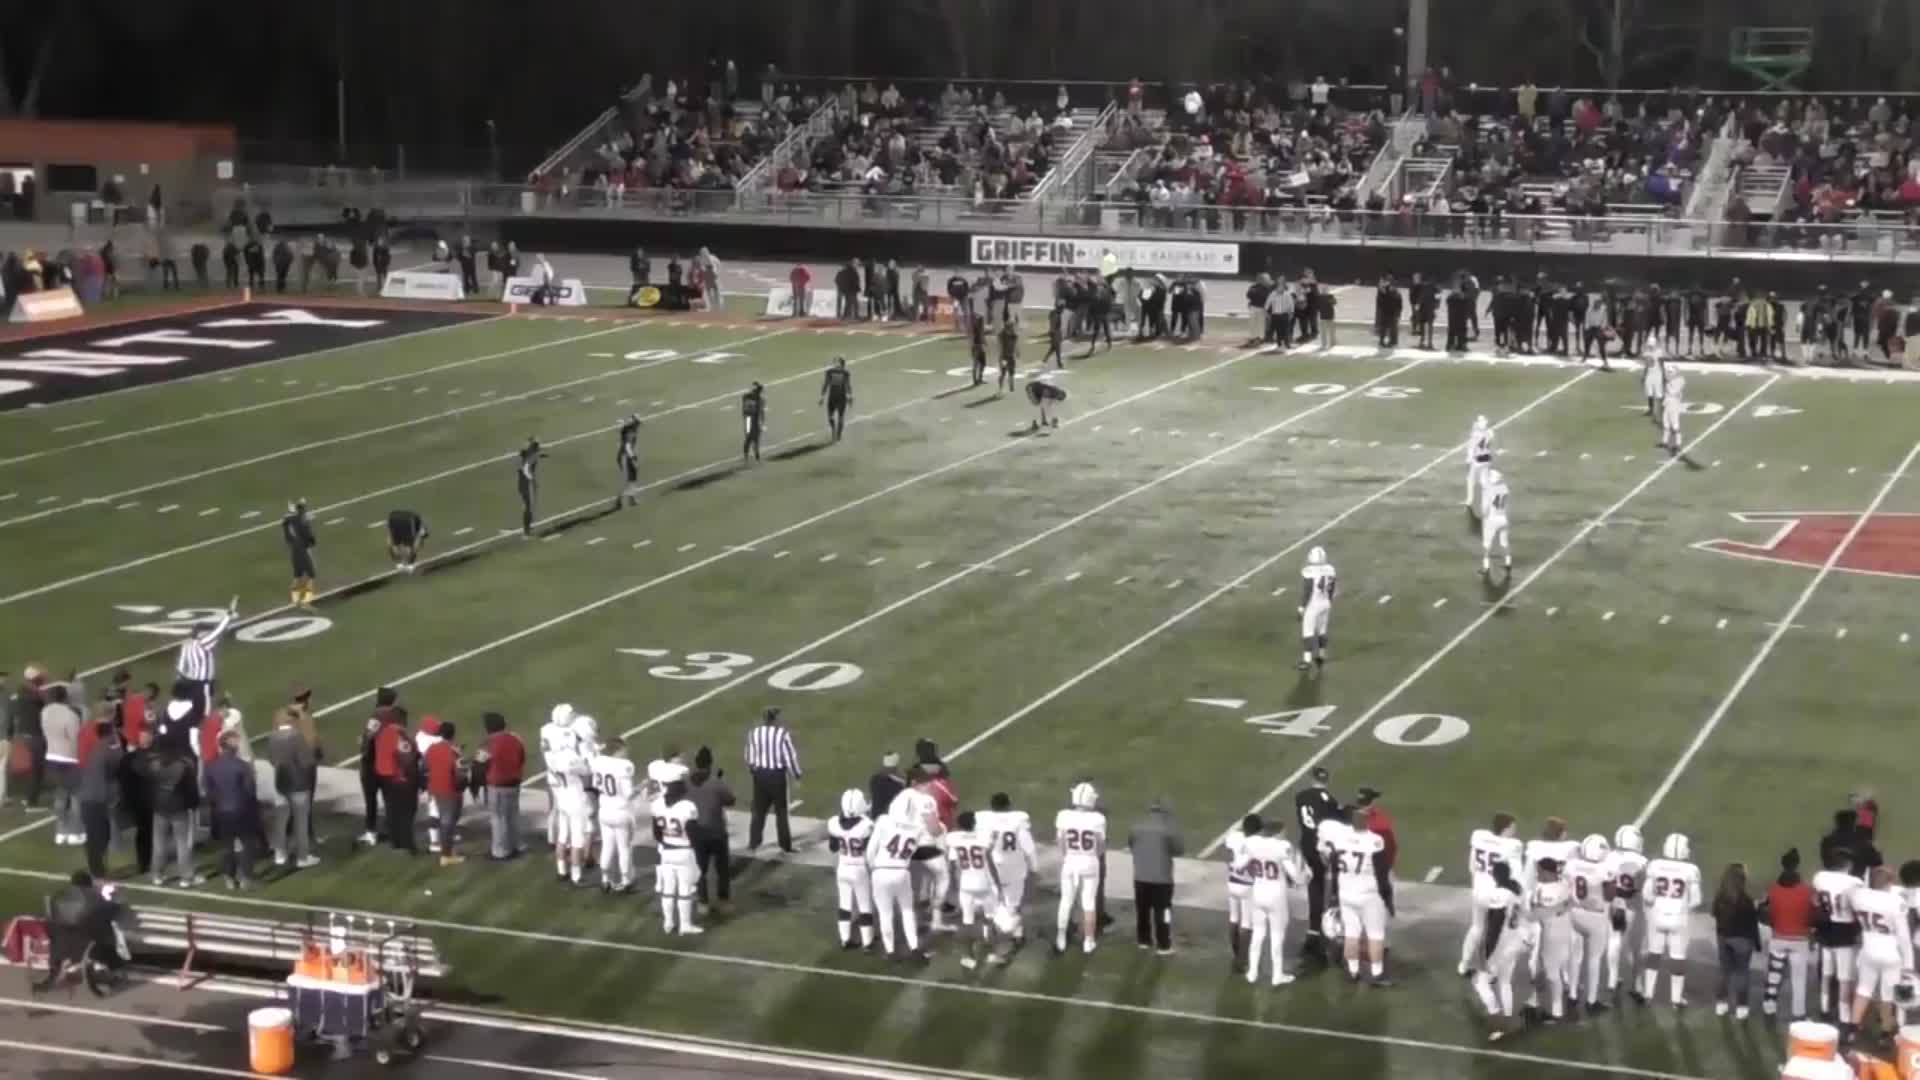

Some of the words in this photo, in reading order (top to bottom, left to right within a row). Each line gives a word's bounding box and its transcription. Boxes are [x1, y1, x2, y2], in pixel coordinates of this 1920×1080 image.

[976, 239, 1075, 264] GRIFFIN
[648, 651, 865, 690] 30
[1244, 704, 1471, 746] 40
[886, 833, 916, 860] 46
[1066, 828, 1095, 851] 26
[1655, 876, 1687, 899] 23
